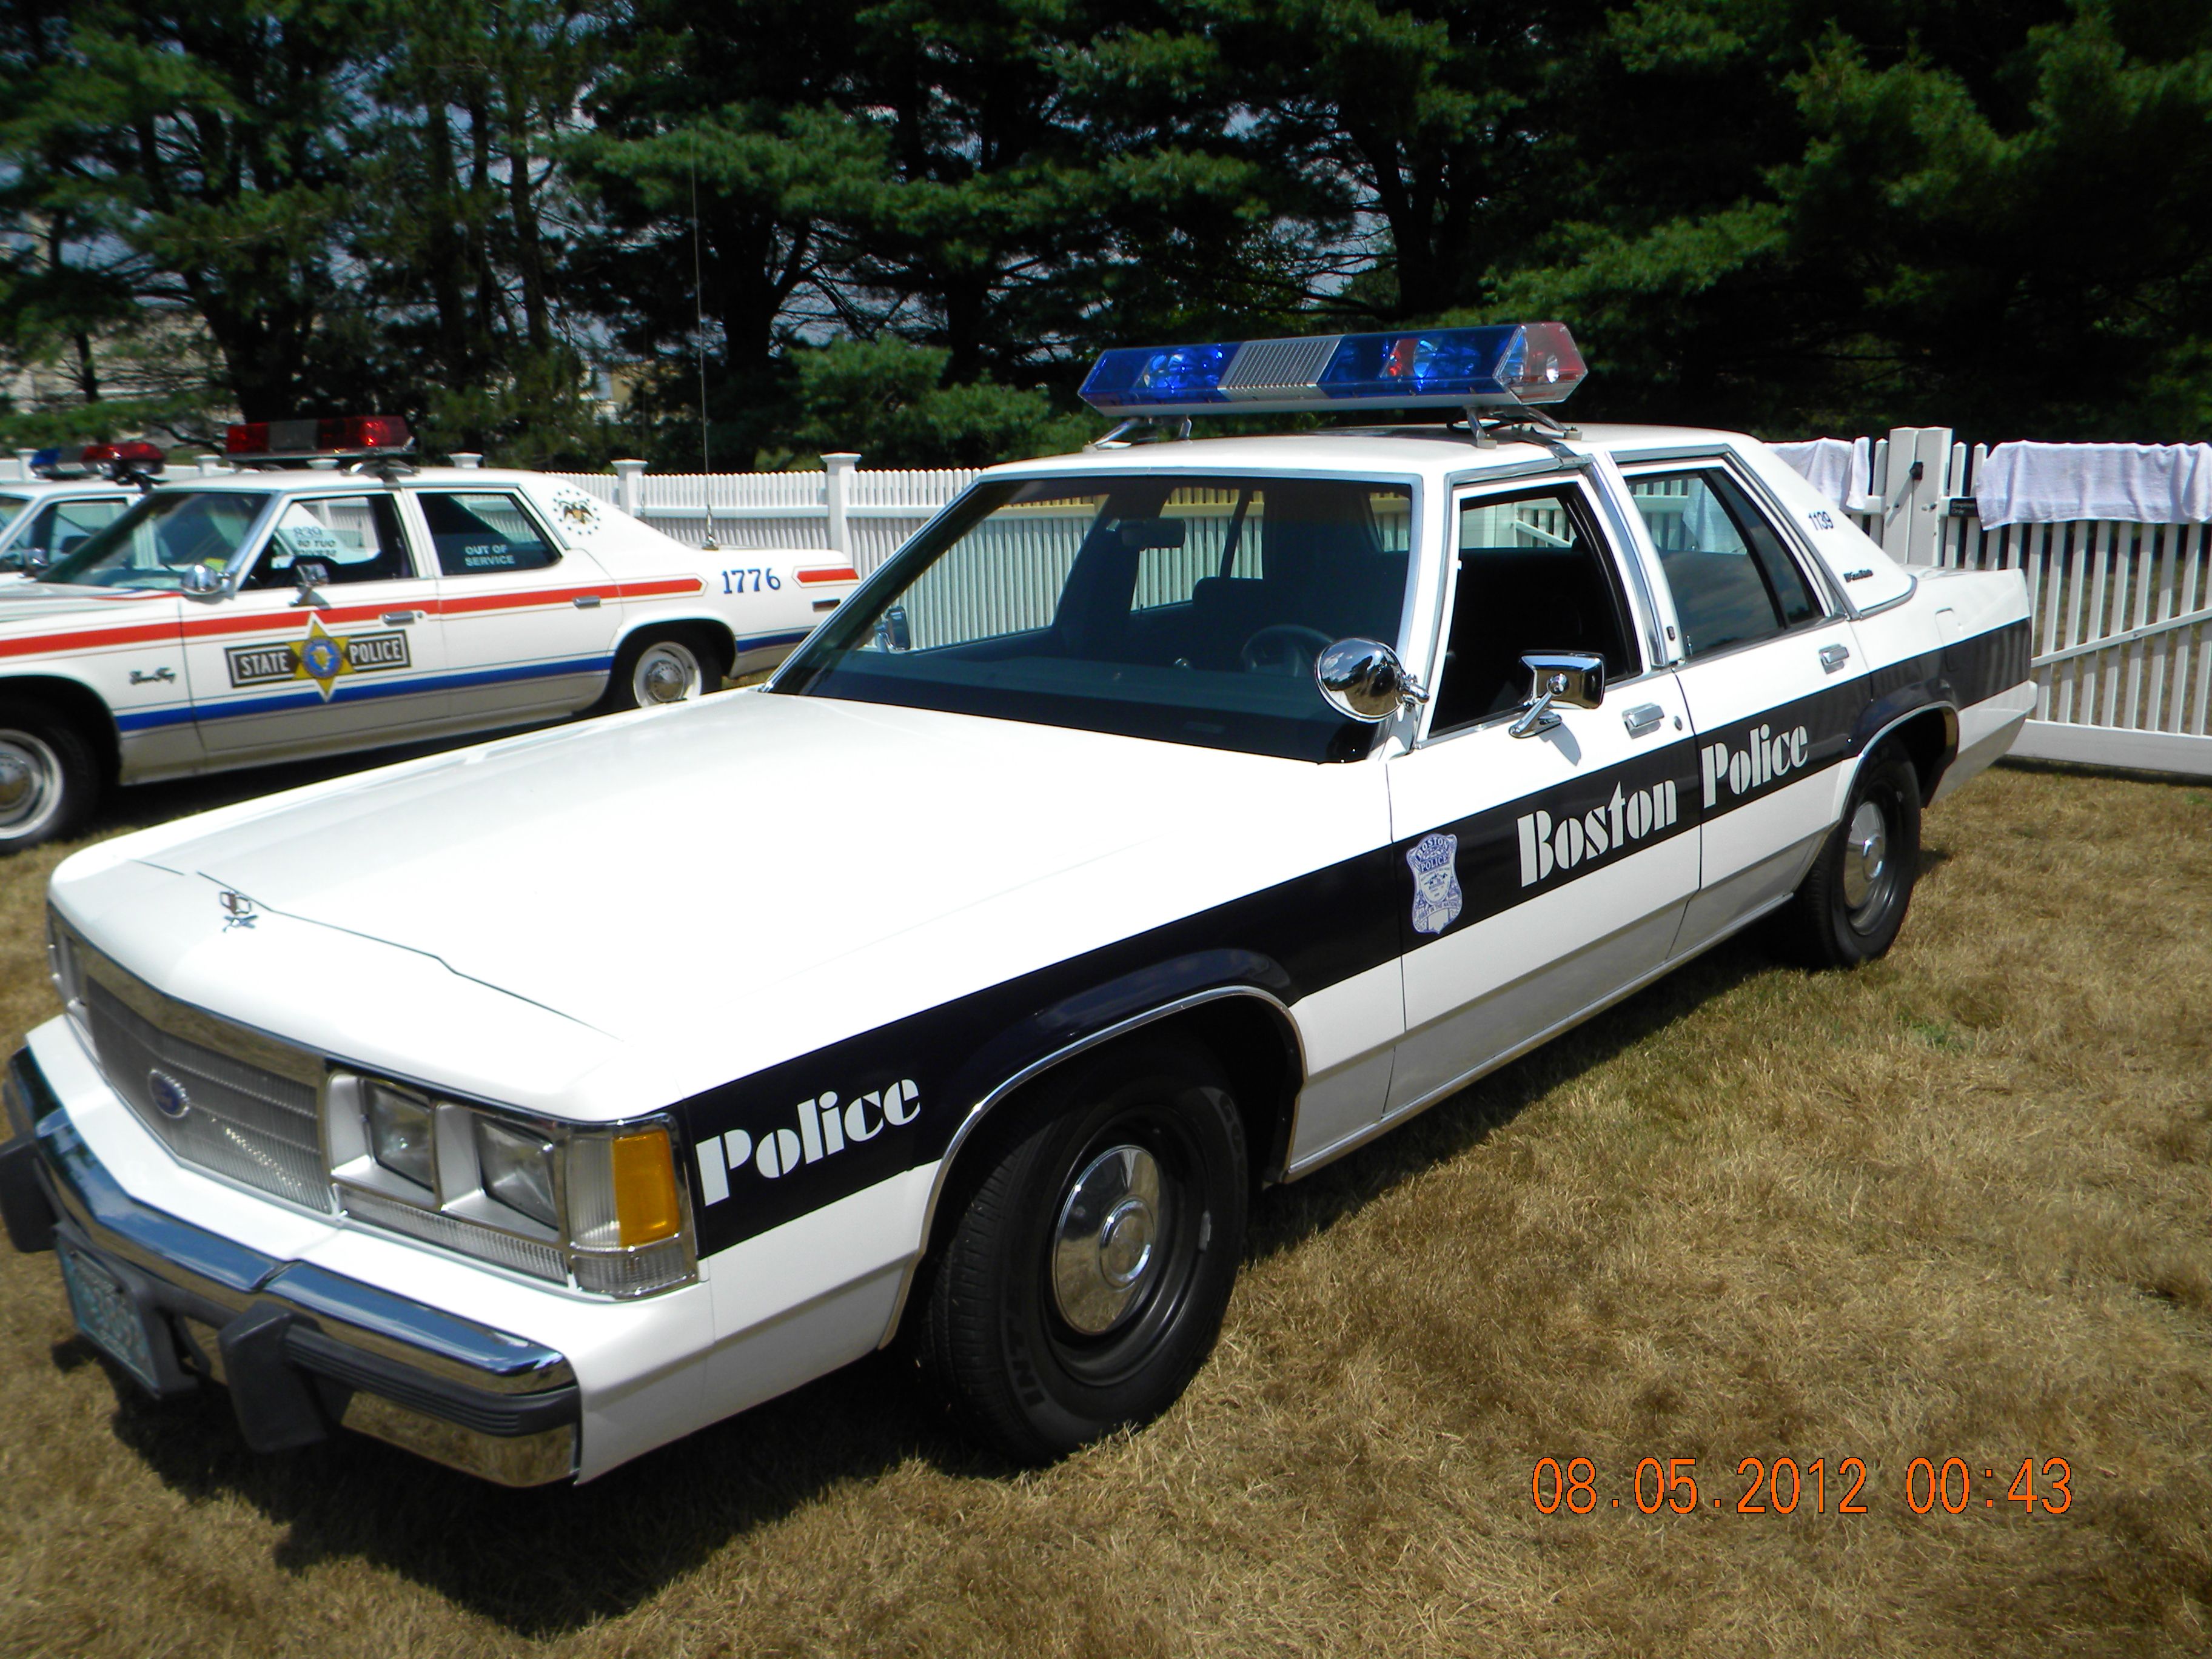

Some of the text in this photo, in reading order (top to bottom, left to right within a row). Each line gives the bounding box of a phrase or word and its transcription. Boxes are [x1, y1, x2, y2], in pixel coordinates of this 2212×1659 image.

[1809, 511, 1834, 531] 1139
[465, 544, 508, 555] OUT OF
[465, 554, 515, 567] SERVICE
[721, 568, 781, 594] 1776
[241, 652, 290, 676] STATE
[349, 640, 402, 665] POLICE
[1517, 723, 1808, 887] Boston Police
[1416, 837, 1450, 858] BOSTON
[1421, 854, 1449, 872] POLICE
[695, 1079, 920, 1207] Police
